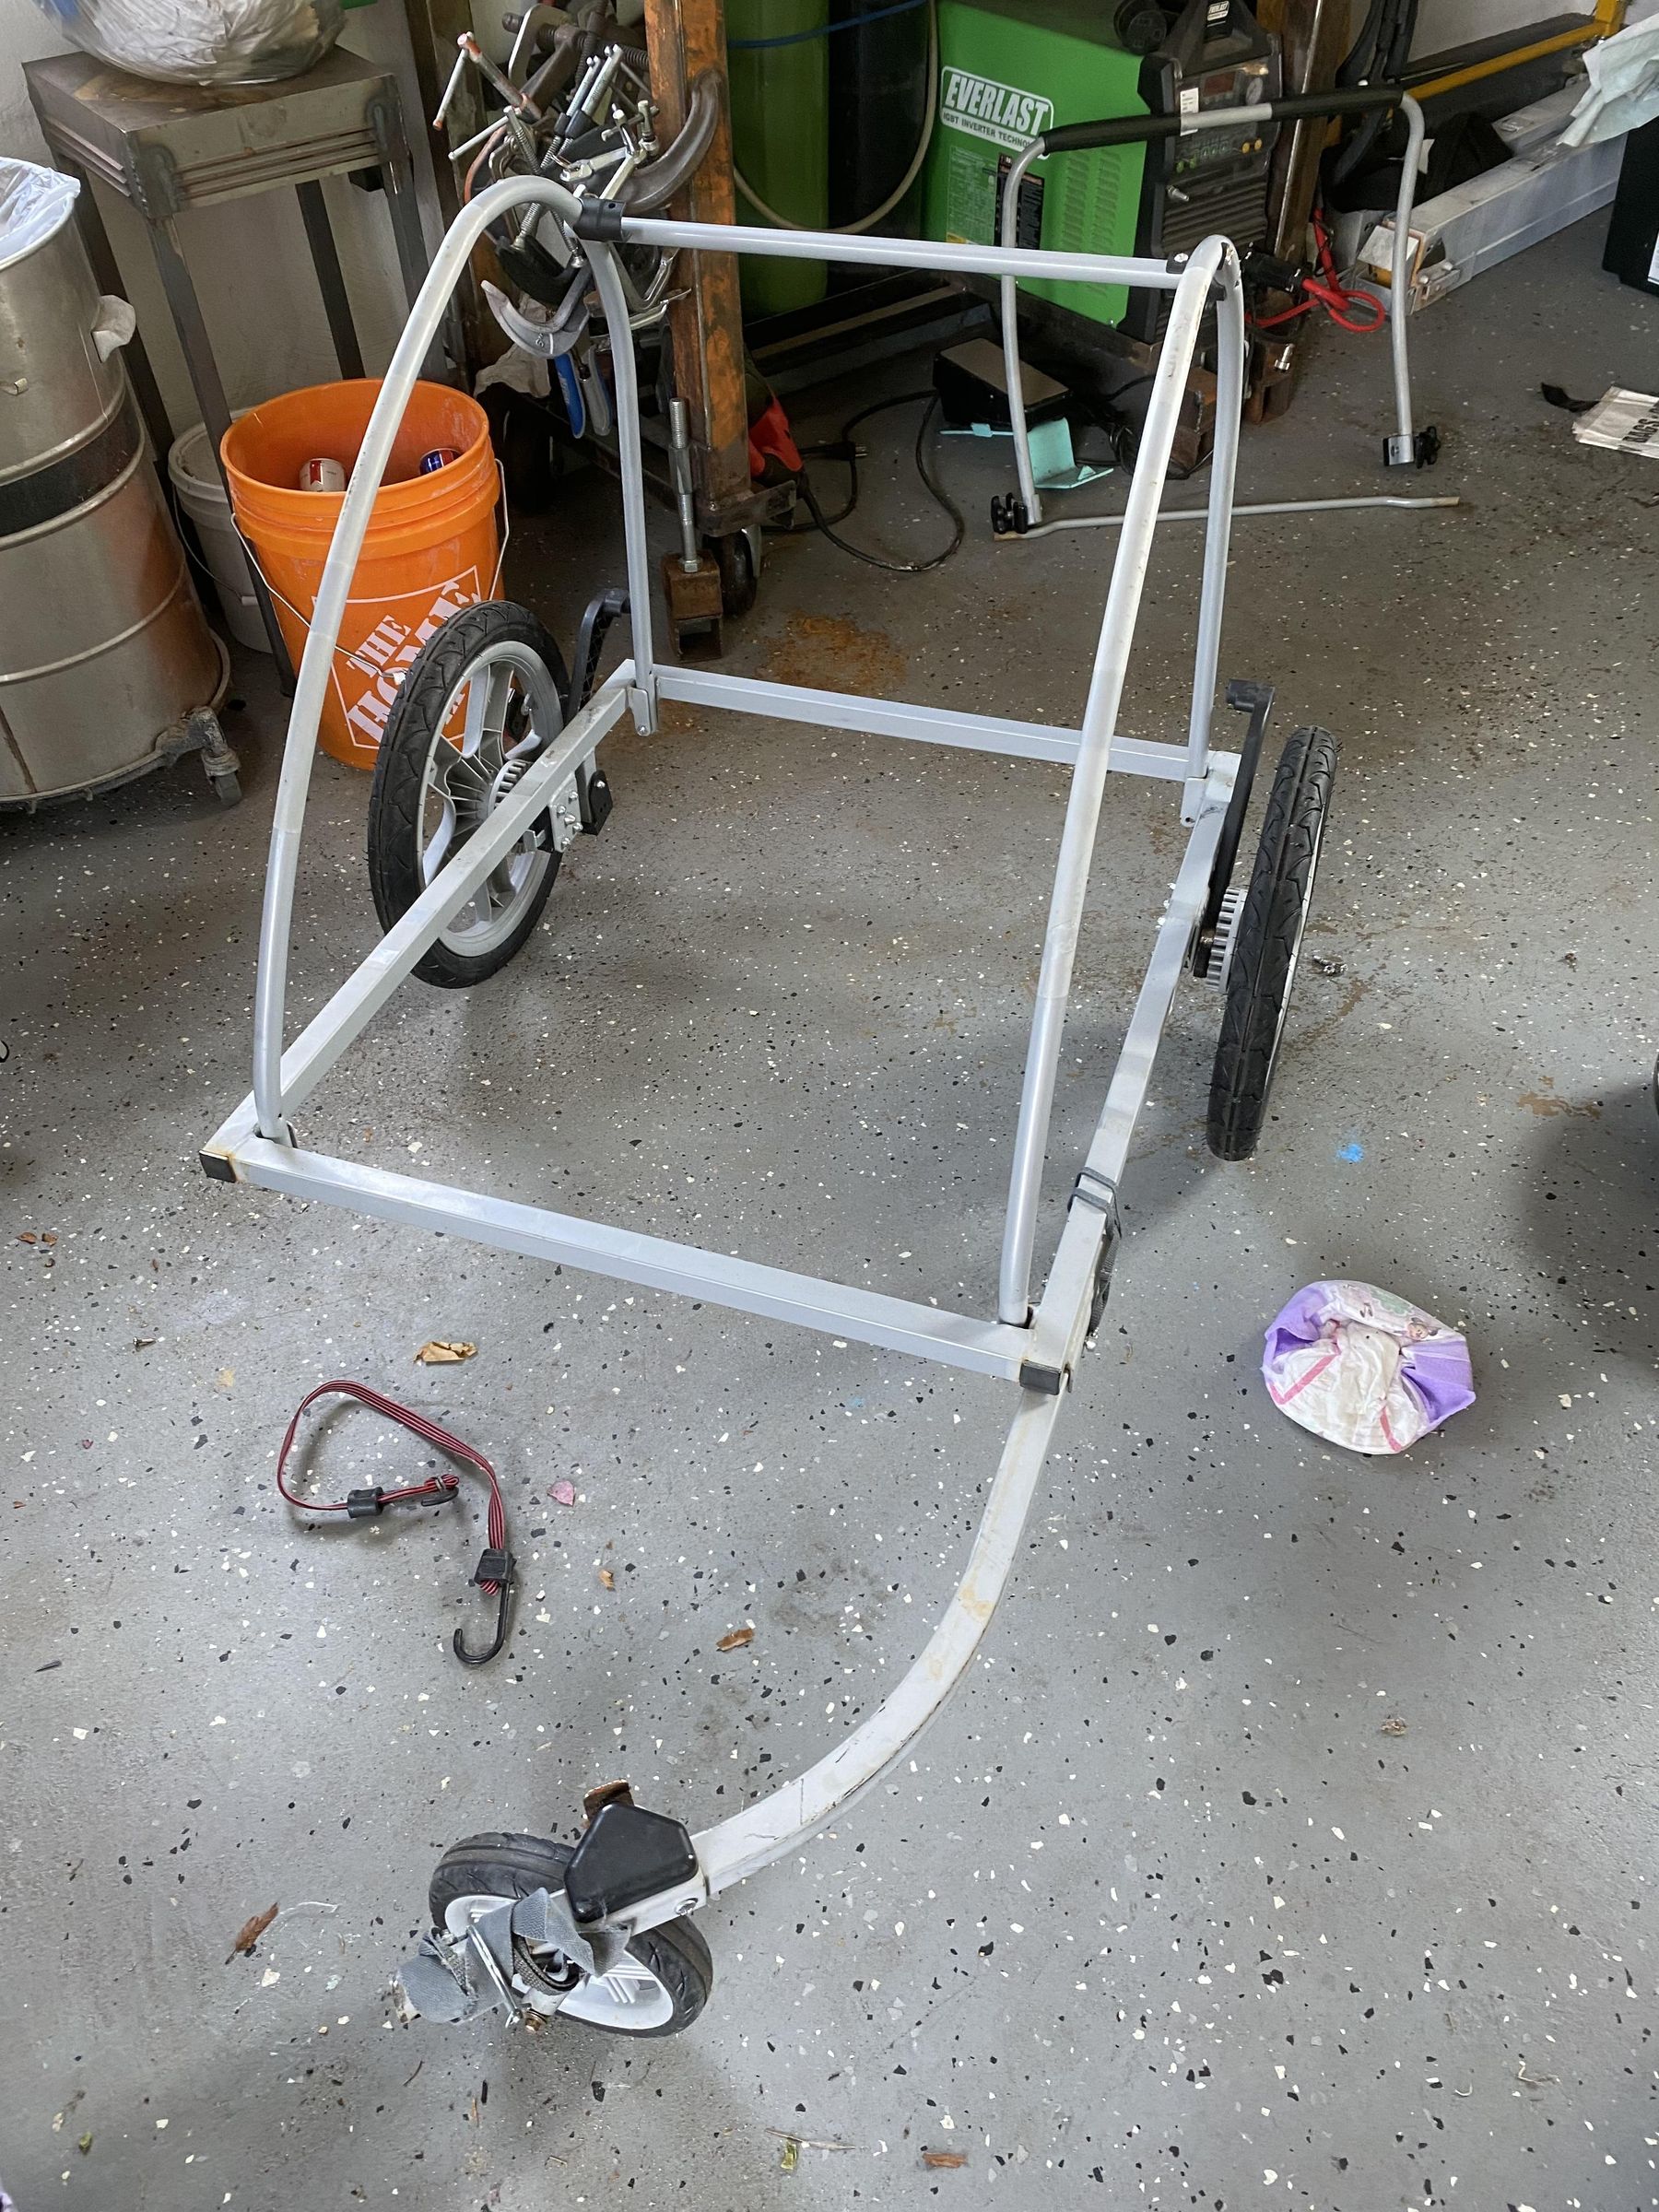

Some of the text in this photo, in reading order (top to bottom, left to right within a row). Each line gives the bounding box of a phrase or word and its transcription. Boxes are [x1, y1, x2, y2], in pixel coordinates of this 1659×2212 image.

[943, 112, 959, 124] IGBT
[961, 117, 996, 137] INVERTER
[945, 74, 1049, 135] EVERLAST
[346, 615, 412, 678] THE
